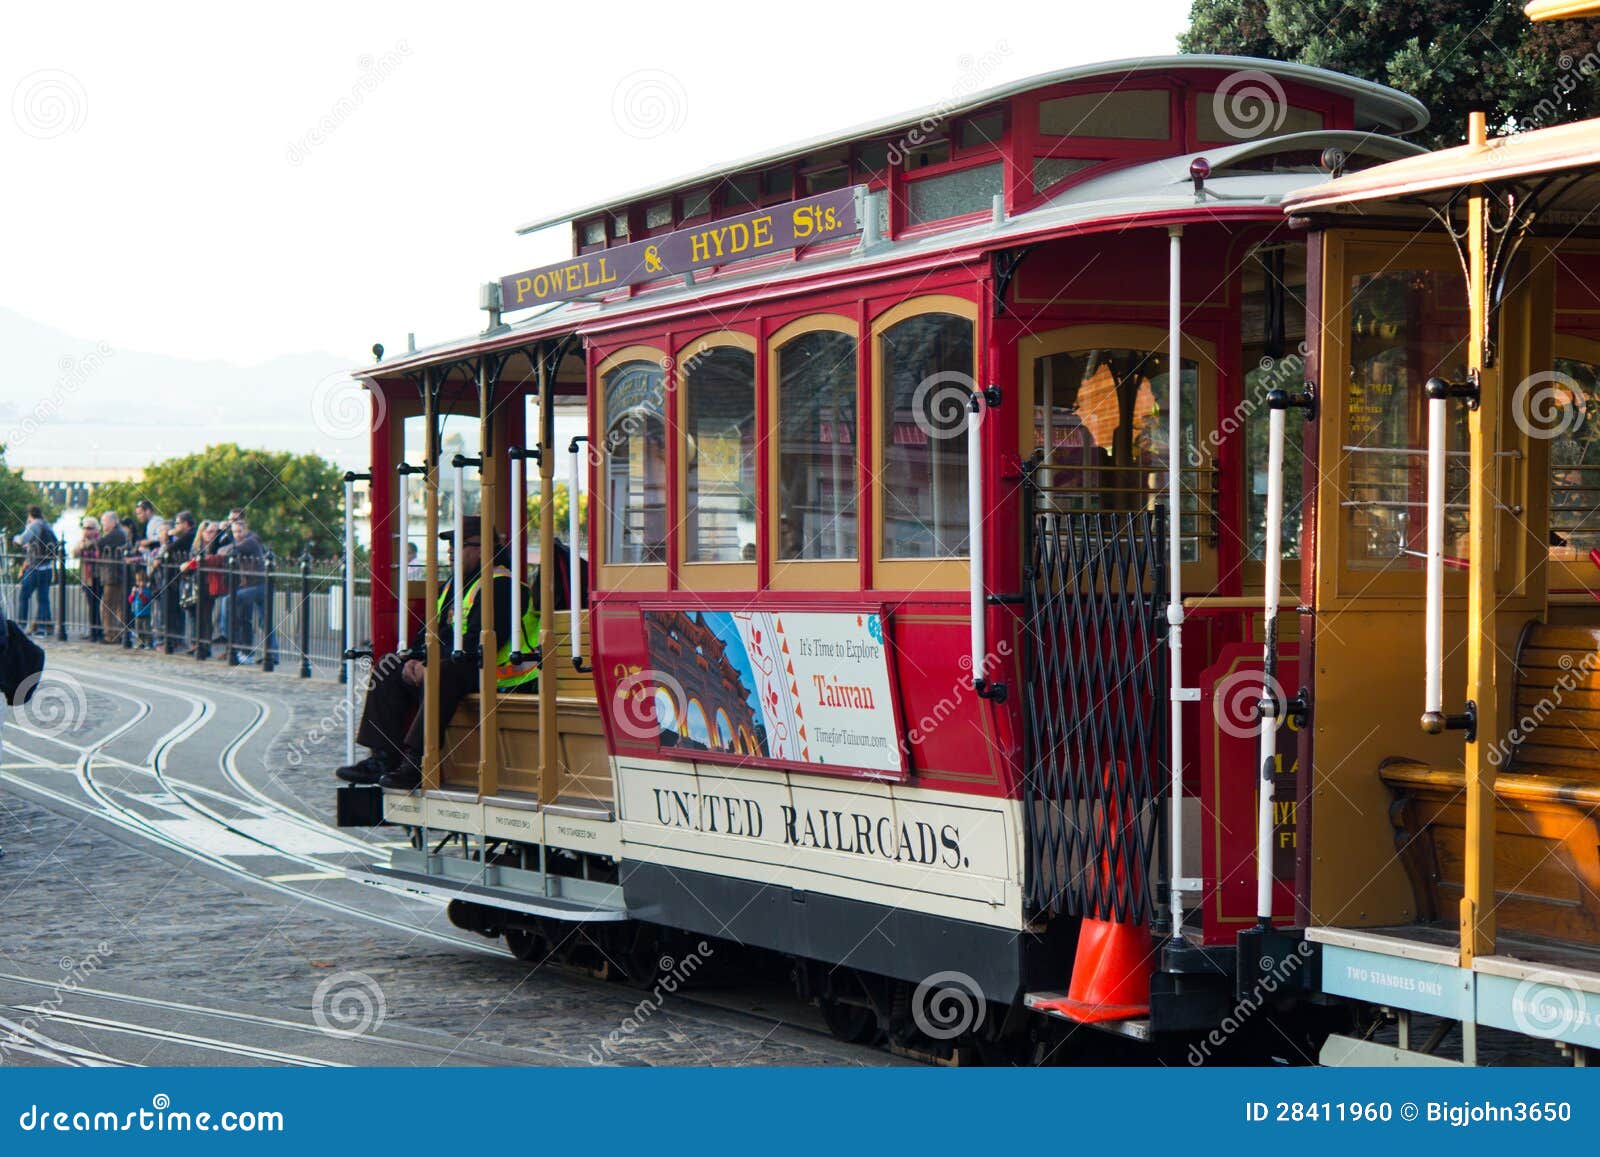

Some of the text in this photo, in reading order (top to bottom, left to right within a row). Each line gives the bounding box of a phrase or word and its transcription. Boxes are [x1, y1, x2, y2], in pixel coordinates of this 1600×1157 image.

[516, 205, 843, 303] POWELL & HYDE Sts.
[800, 639, 880, 663] It's Time to Explore
[813, 675, 876, 710] Taiwan
[814, 728, 888, 749] TimeforTaiwan.com
[780, 805, 969, 869] RAILROADS.
[1347, 966, 1443, 996] TWO STANDEES ONLY
